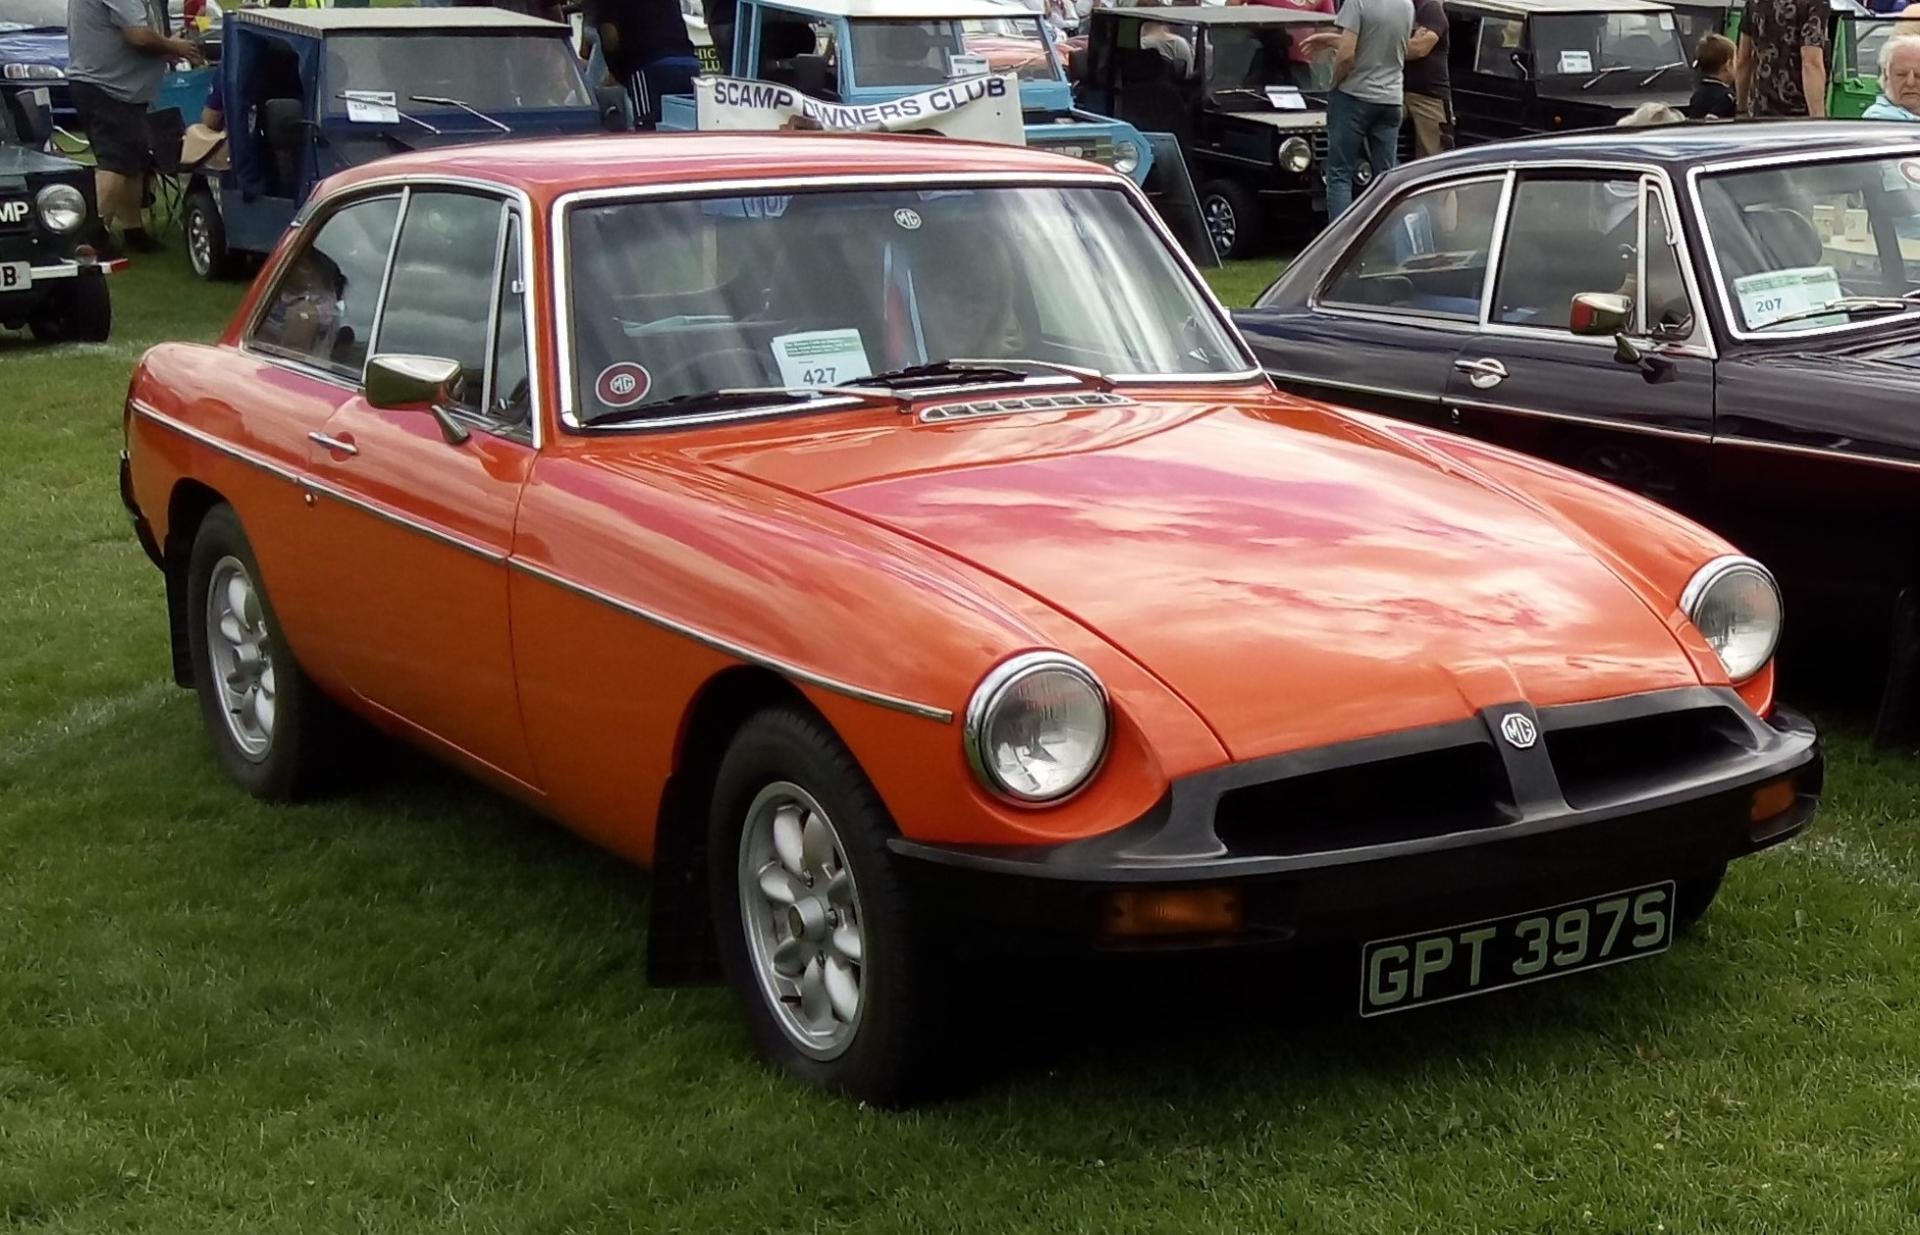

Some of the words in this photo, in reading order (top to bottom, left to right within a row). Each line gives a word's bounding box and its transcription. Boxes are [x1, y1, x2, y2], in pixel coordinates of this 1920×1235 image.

[714, 81, 793, 109] SCAMP
[802, 98, 921, 128] OWNERS
[930, 78, 1006, 111] CLUB
[896, 210, 920, 227] MG
[1755, 298, 1782, 313] 207
[612, 375, 634, 393] MG
[802, 367, 837, 385] 427
[1505, 716, 1534, 744] MG
[1368, 926, 1497, 1006] GPT
[1512, 890, 1666, 975] 397S
